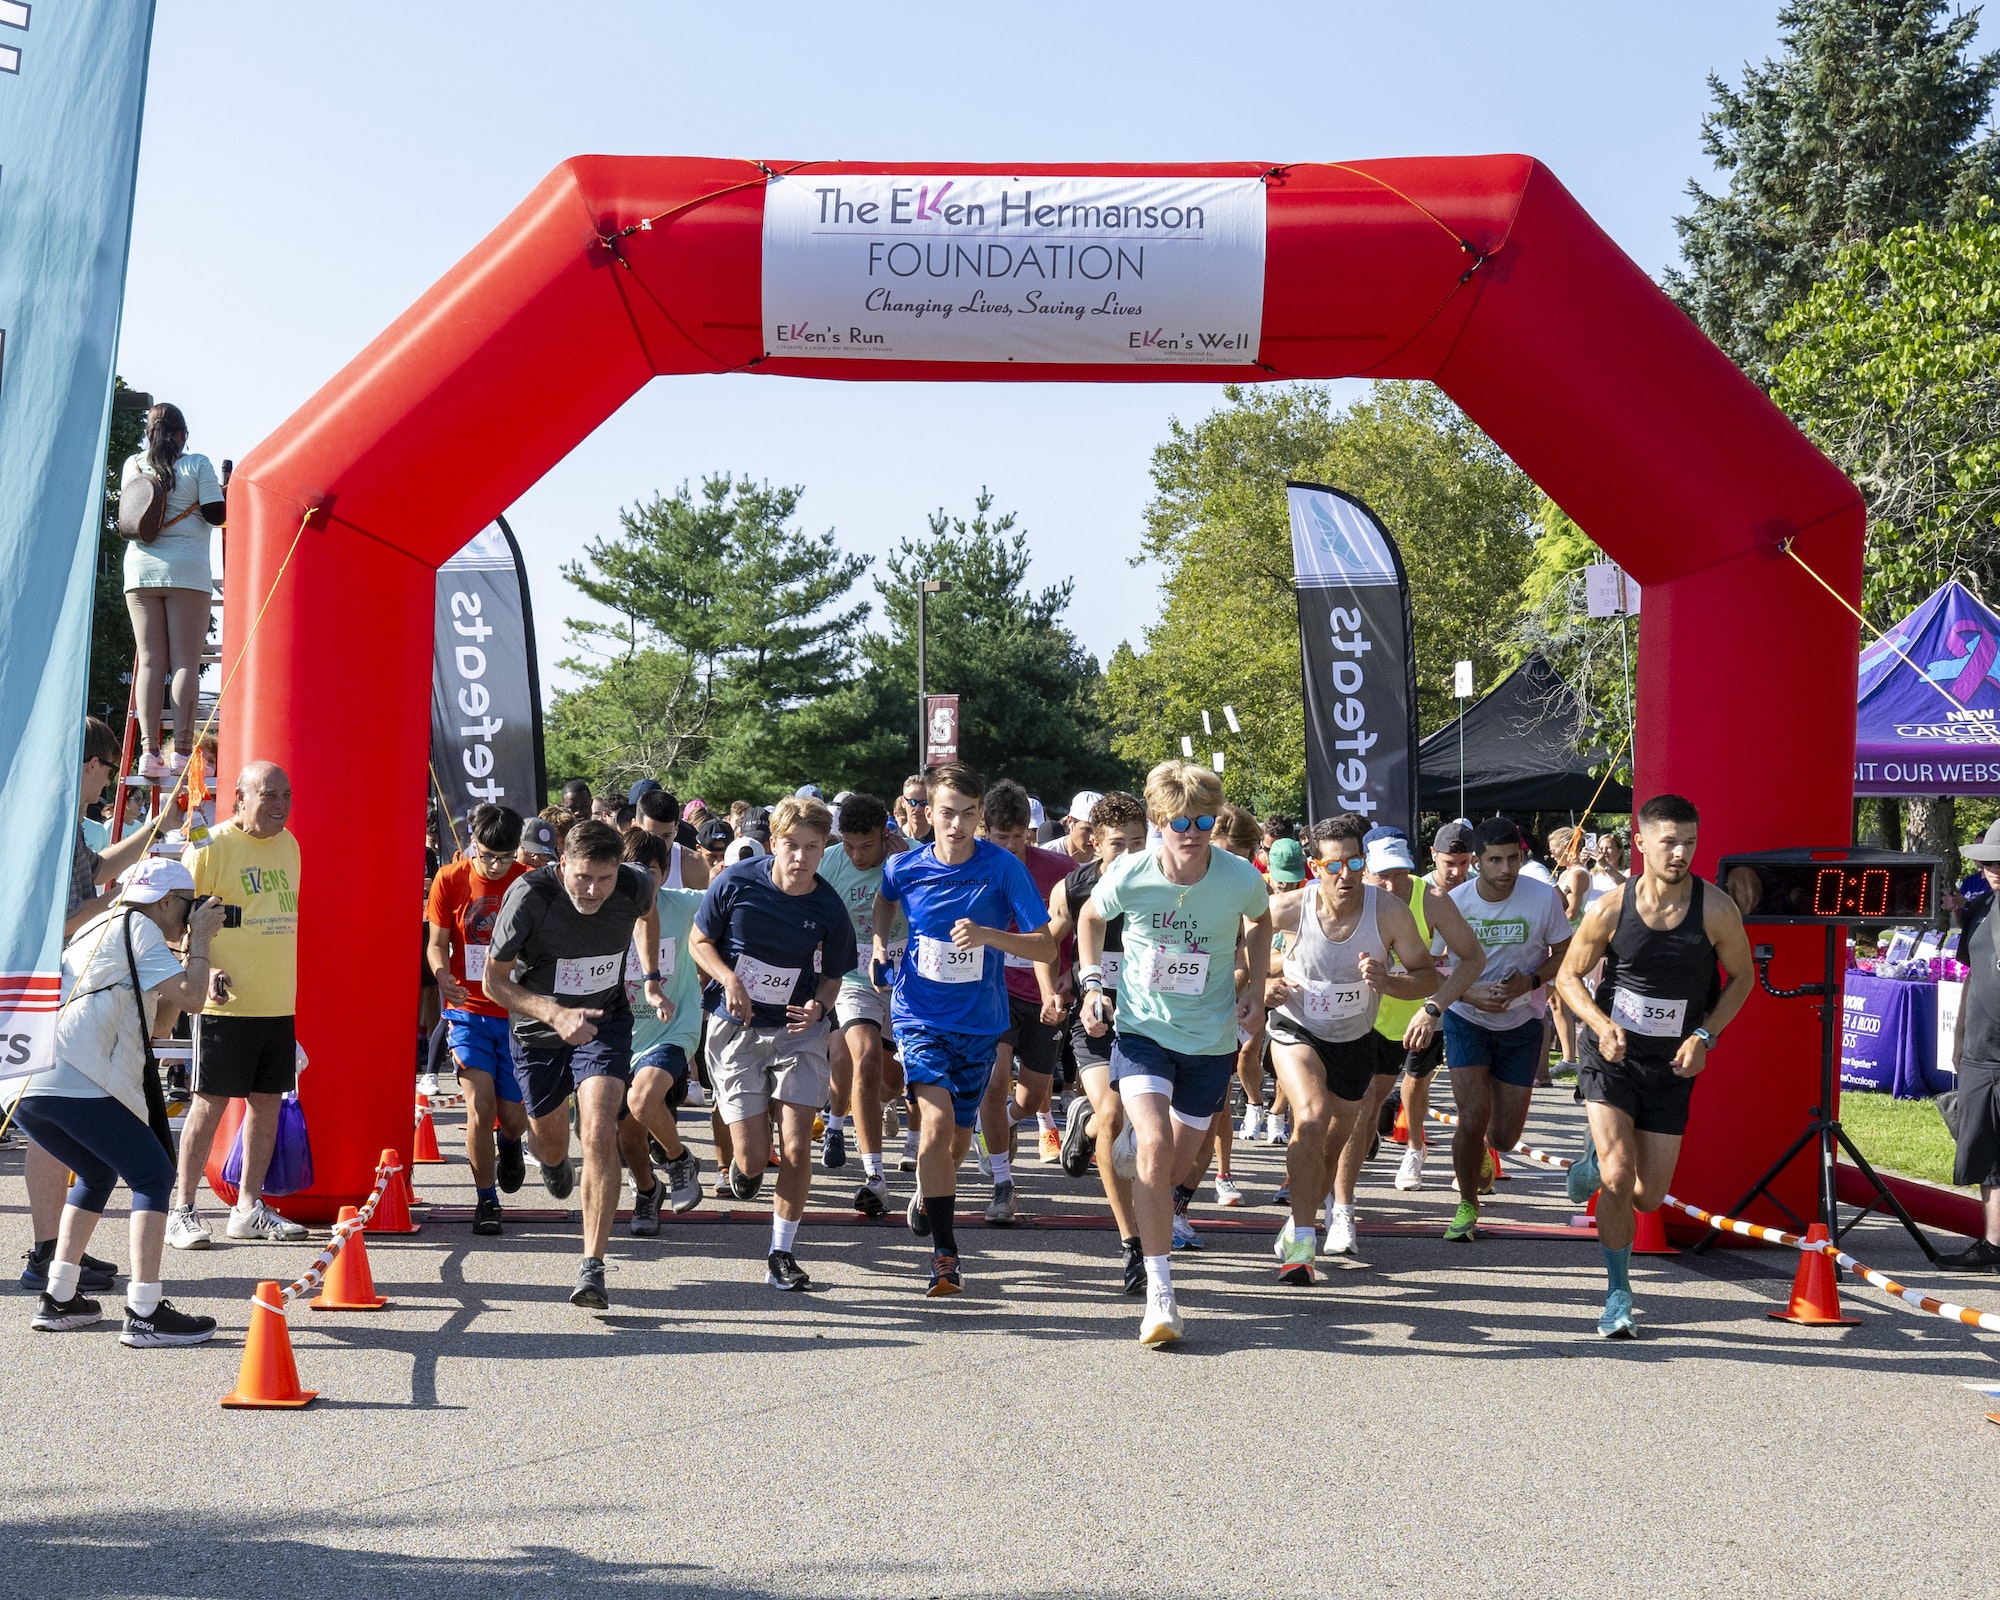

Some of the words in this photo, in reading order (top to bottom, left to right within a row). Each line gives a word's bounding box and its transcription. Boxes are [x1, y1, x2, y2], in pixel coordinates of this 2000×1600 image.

[814, 188, 880, 224] The
[1000, 190, 1204, 230] Hermanson
[868, 242, 1144, 280] FOUNDATION
[865, 287, 953, 319] Changing
[958, 289, 1014, 316] Lives,
[1017, 290, 1086, 321] Saving
[1090, 291, 1143, 316] Lives
[849, 327, 884, 344] Run
[1197, 333, 1249, 350] Well
[1945, 708, 1995, 722] NEW
[1896, 723, 2000, 737] CANCER
[1883, 762, 1934, 782] OUR
[1184, 930, 1209, 945] Run
[1475, 926, 1500, 938] NYC
[1503, 925, 1523, 936] 1/2
[947, 951, 975, 965] 391
[589, 961, 614, 977] 169
[1167, 962, 1200, 975] 655
[761, 974, 792, 988] 284
[1335, 989, 1360, 1003] 731
[1643, 1006, 1677, 1020] 354
[1856, 1016, 1881, 1034] BLOOD
[129, 1318, 156, 1332] HOKA
